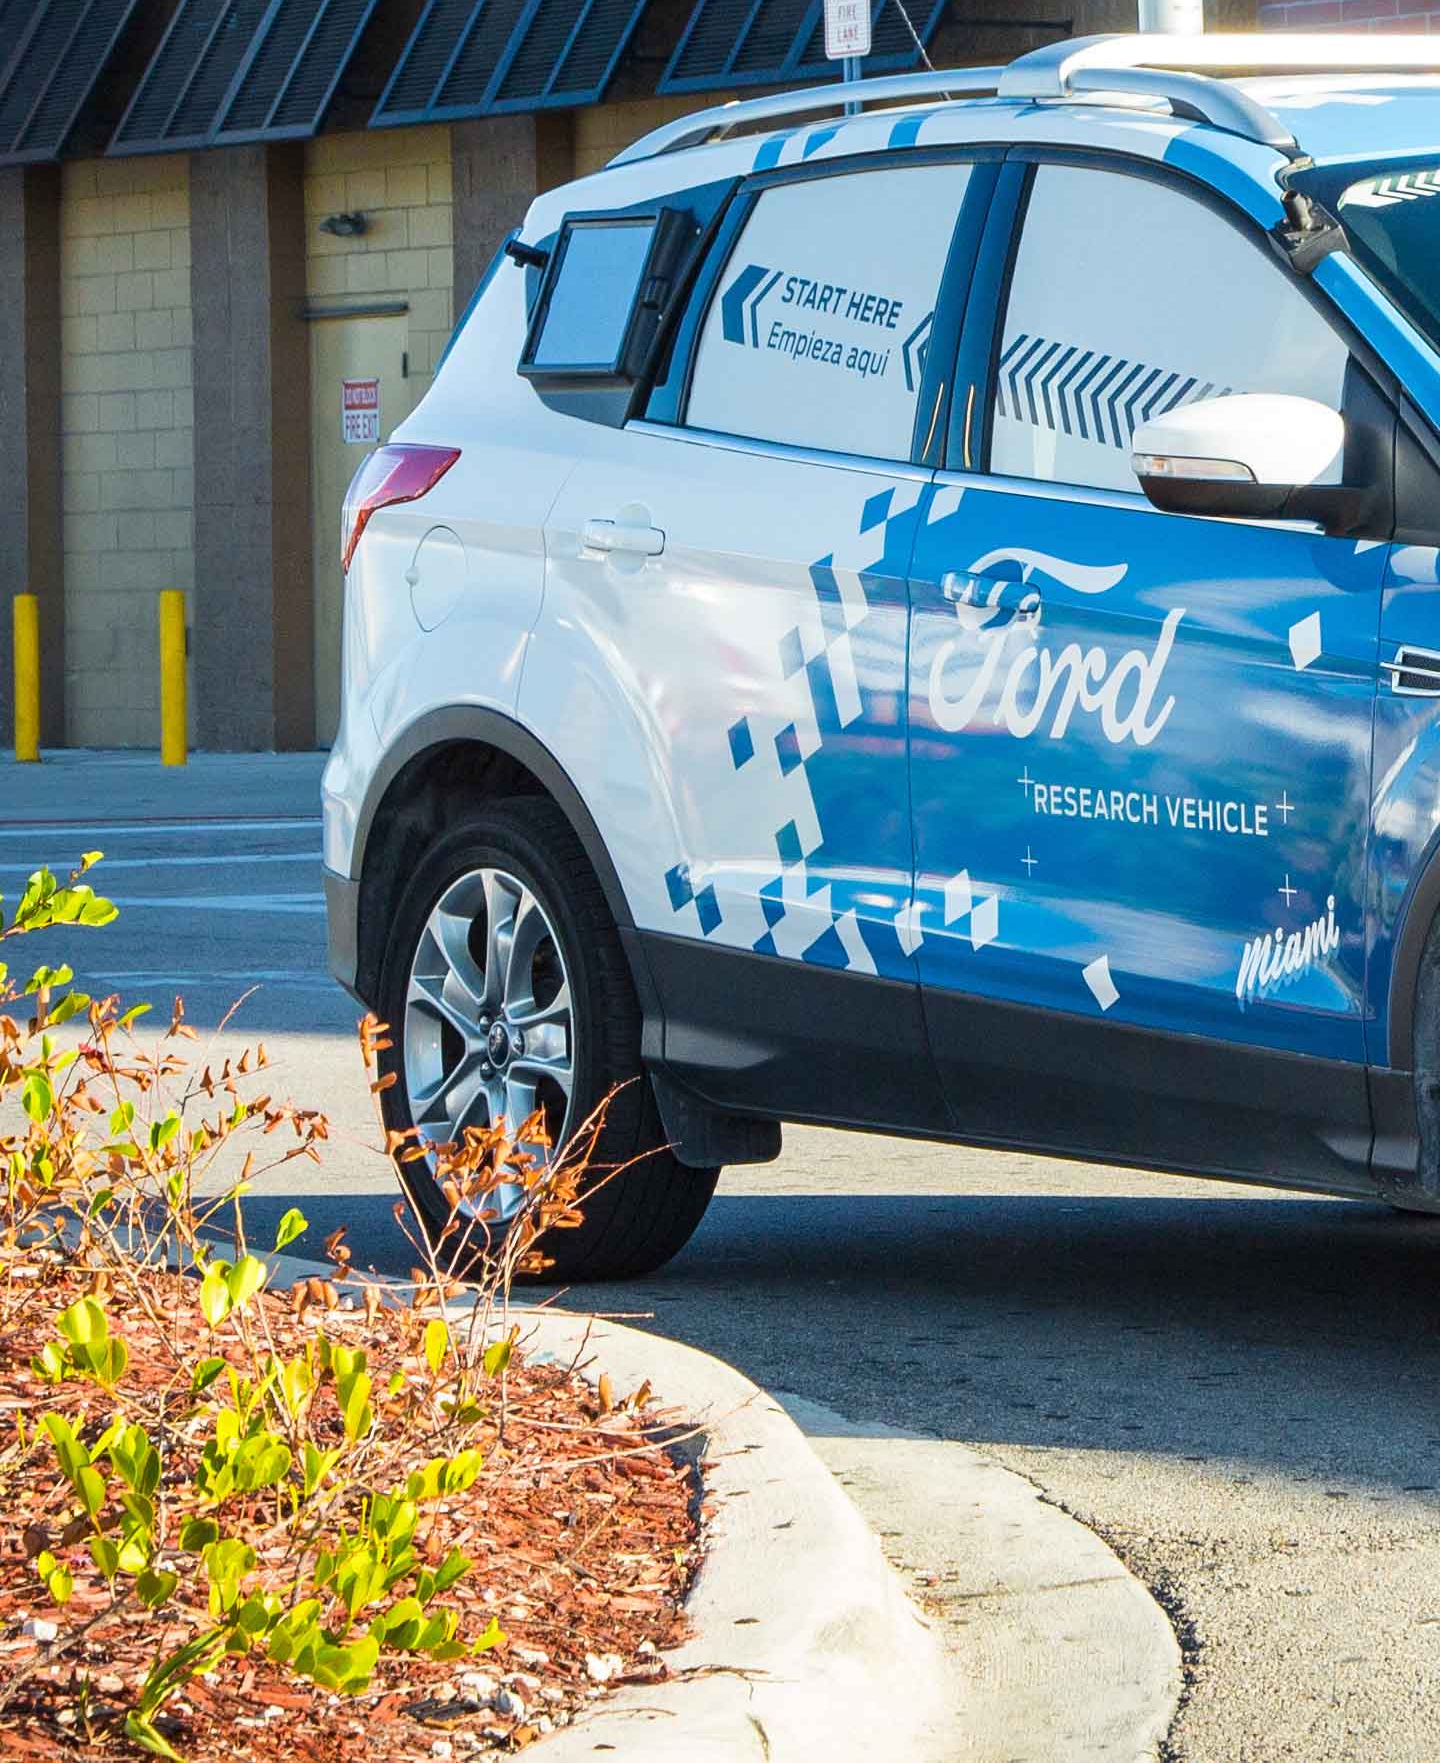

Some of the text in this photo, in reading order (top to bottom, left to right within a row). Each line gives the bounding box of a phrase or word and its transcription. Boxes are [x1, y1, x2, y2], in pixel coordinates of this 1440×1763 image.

[781, 276, 903, 329] START HERE
[766, 321, 843, 365] Empieza
[929, 547, 1187, 746] Ford
[1033, 783, 1269, 836] RESEARCH VEHICLE
